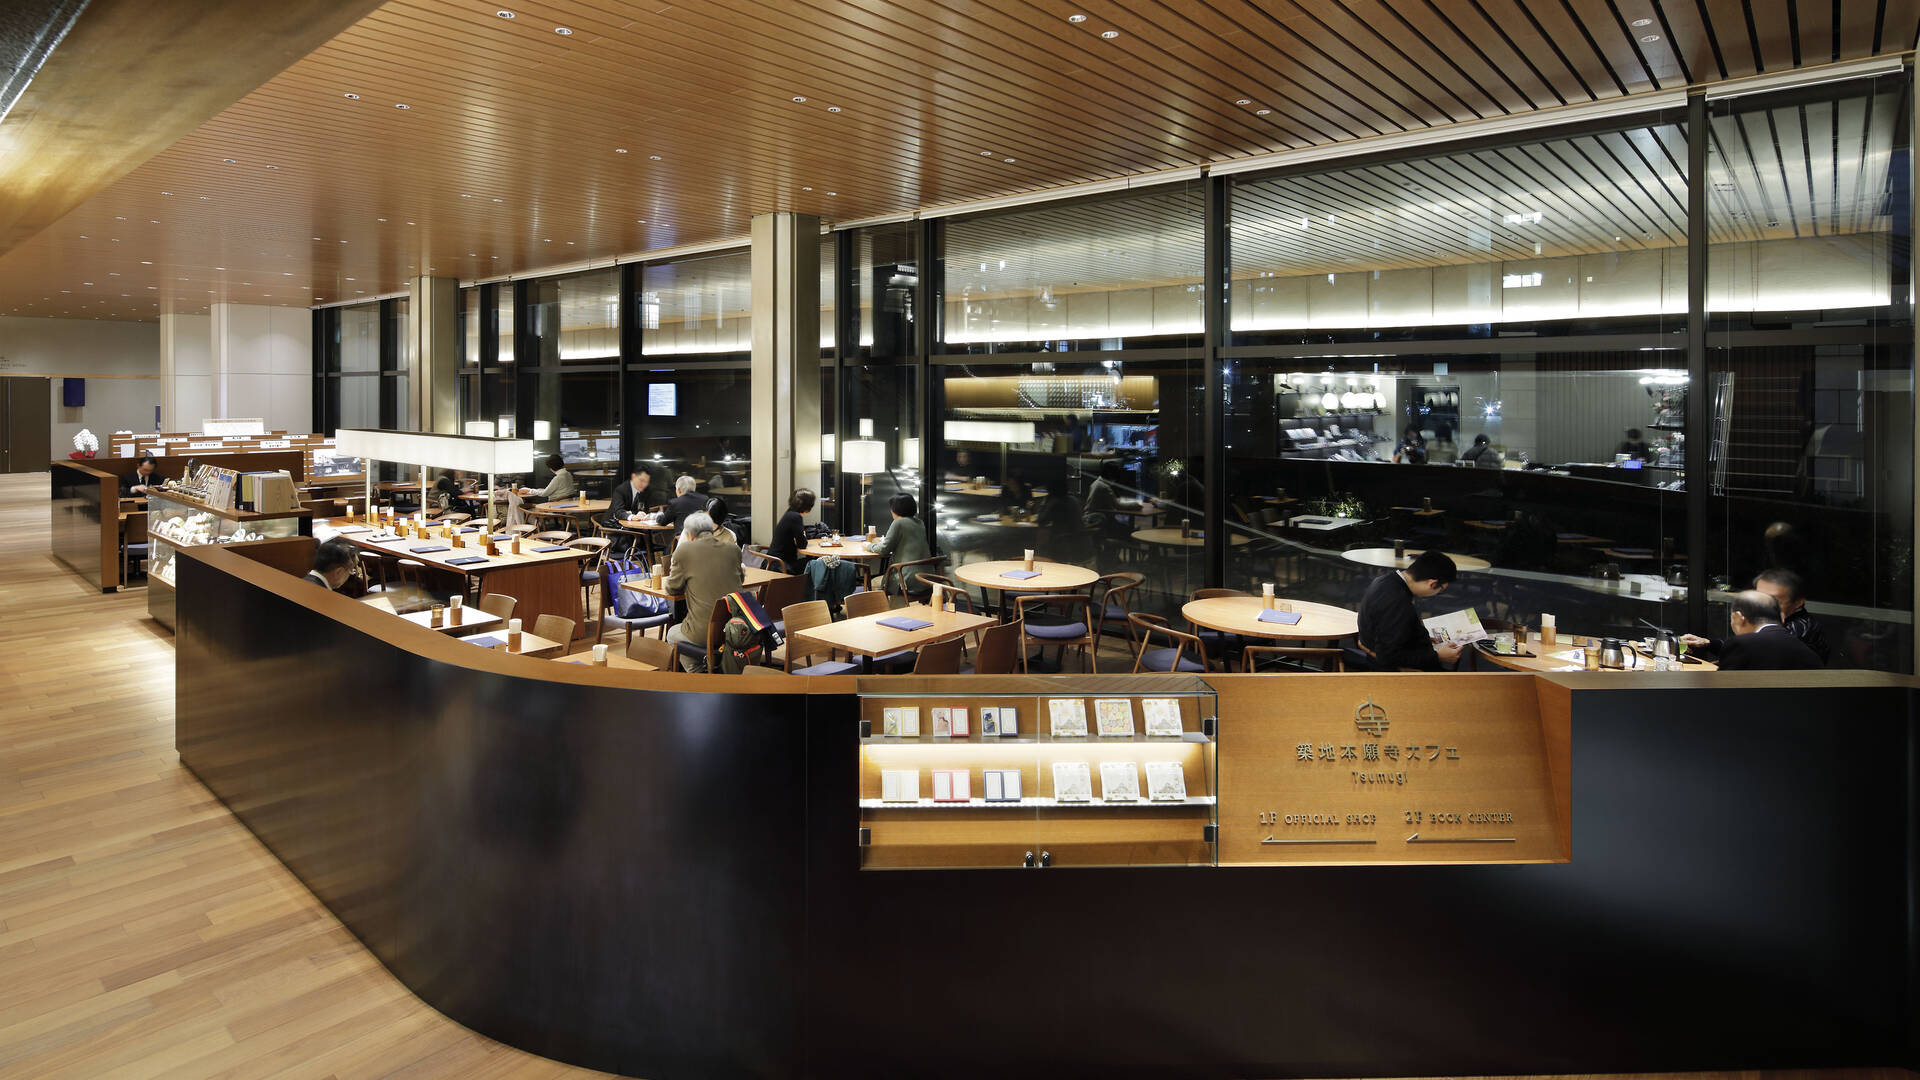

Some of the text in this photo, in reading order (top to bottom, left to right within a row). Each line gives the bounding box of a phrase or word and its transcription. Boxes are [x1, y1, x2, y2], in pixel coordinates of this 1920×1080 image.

[1296, 742, 1460, 762] 築地本願寺カフェ
[1352, 769, 1408, 785] Tsumugi
[1260, 811, 1376, 825] 1F OFFICIAL SHOP
[1404, 810, 1513, 824] 2F BOOK CENTER
